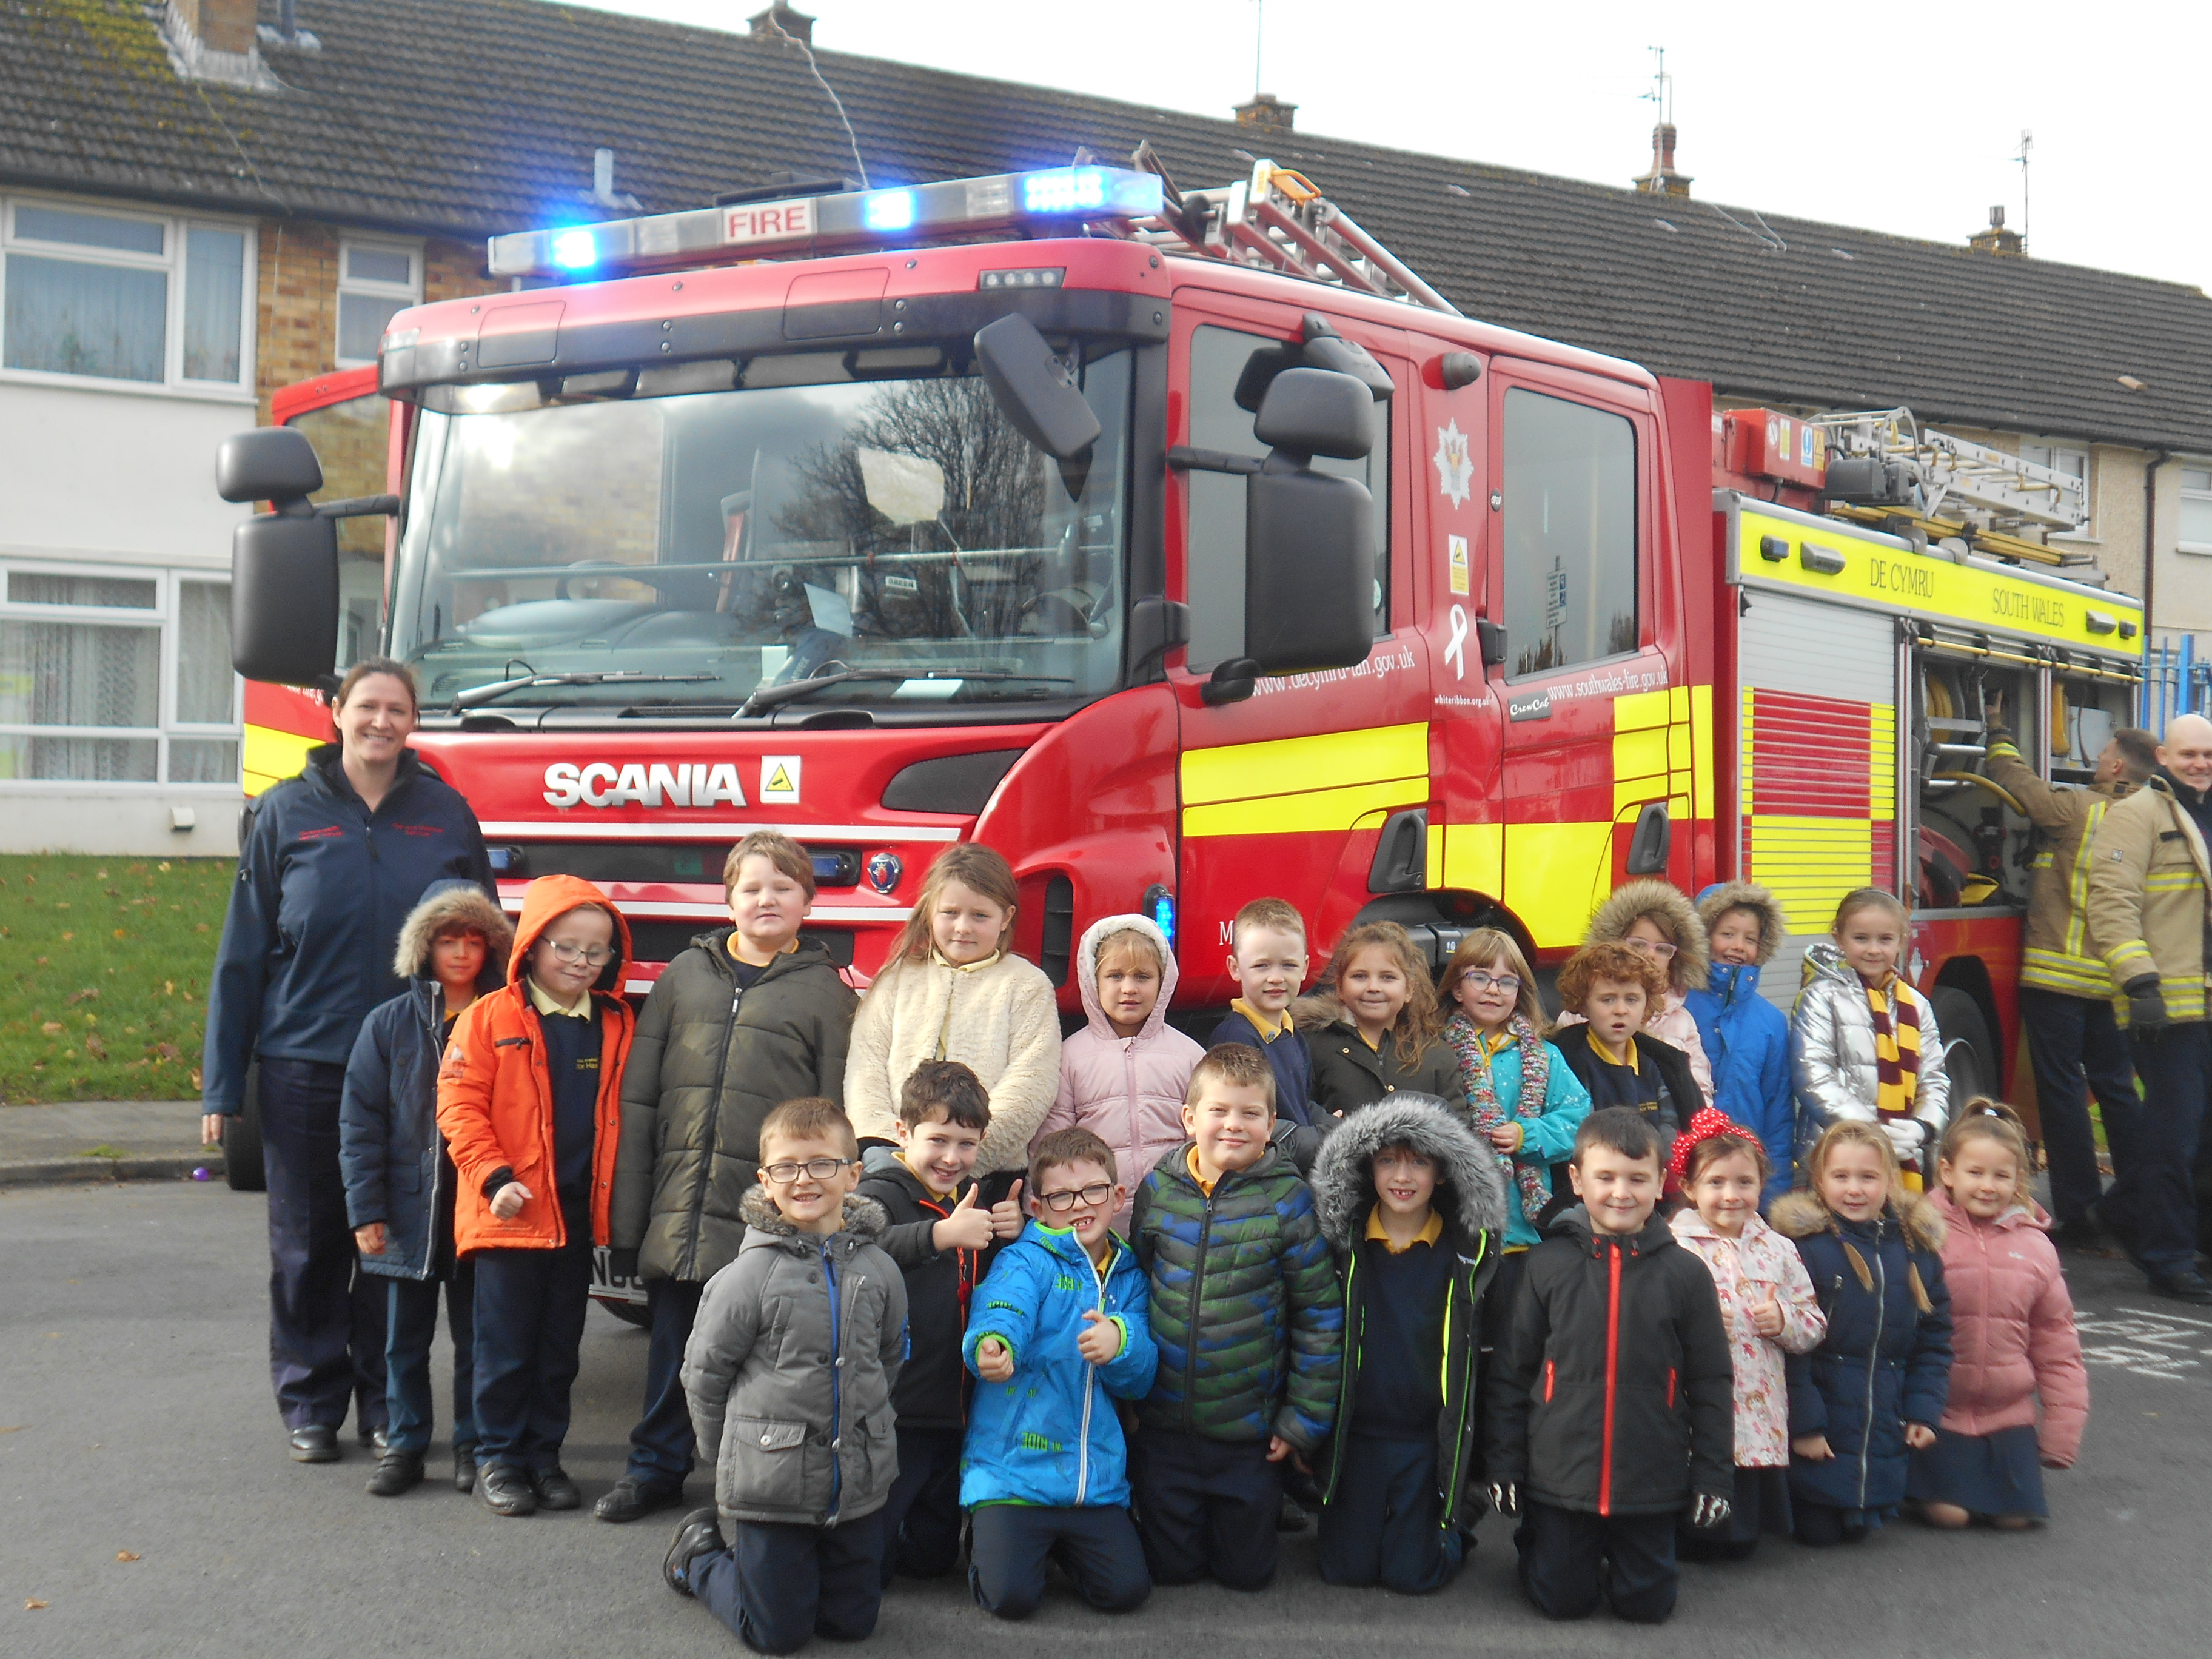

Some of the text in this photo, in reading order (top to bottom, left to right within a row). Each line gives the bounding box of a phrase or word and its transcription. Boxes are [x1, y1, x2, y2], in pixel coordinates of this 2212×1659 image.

[729, 206, 806, 238] FIRE
[1870, 558, 1934, 598] DE CYMRU
[1992, 587, 2065, 628] SOUTH WALES
[1435, 694, 1490, 708] whiteribbon.org.uk
[1547, 664, 1669, 701] www.southwales-fire.gov.uk
[542, 762, 748, 808] SCANIA
